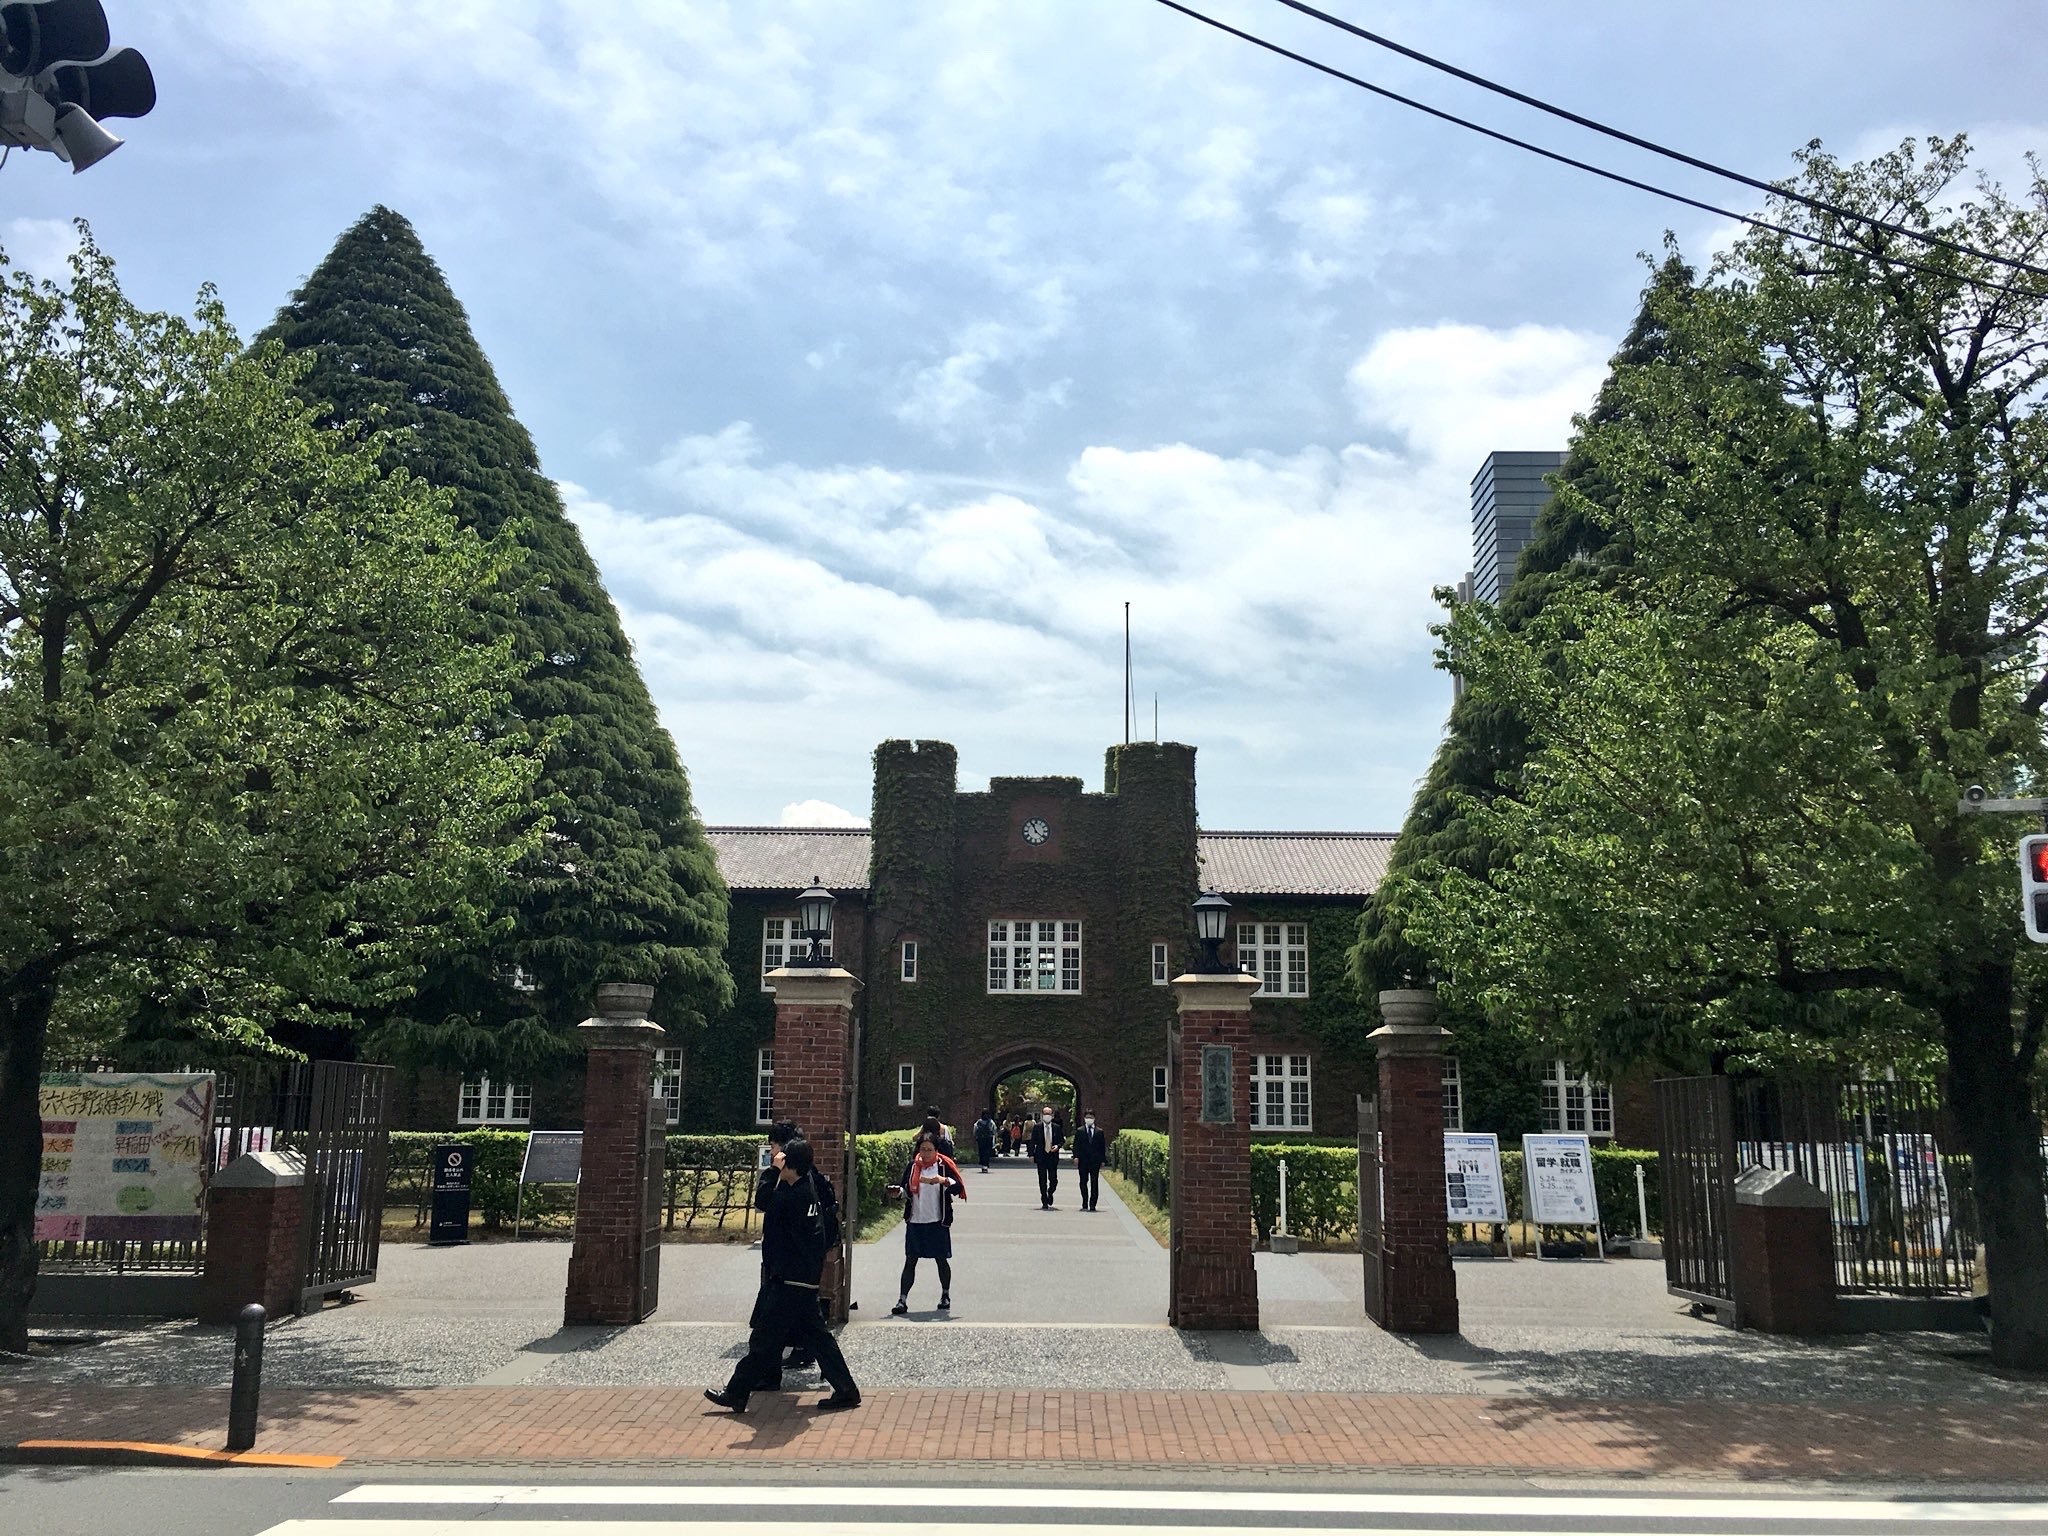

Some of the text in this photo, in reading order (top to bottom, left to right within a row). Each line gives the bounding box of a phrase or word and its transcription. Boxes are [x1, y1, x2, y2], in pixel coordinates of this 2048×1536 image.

[115, 1135, 151, 1154] 早稲田
[114, 1158, 150, 1172] イベント
